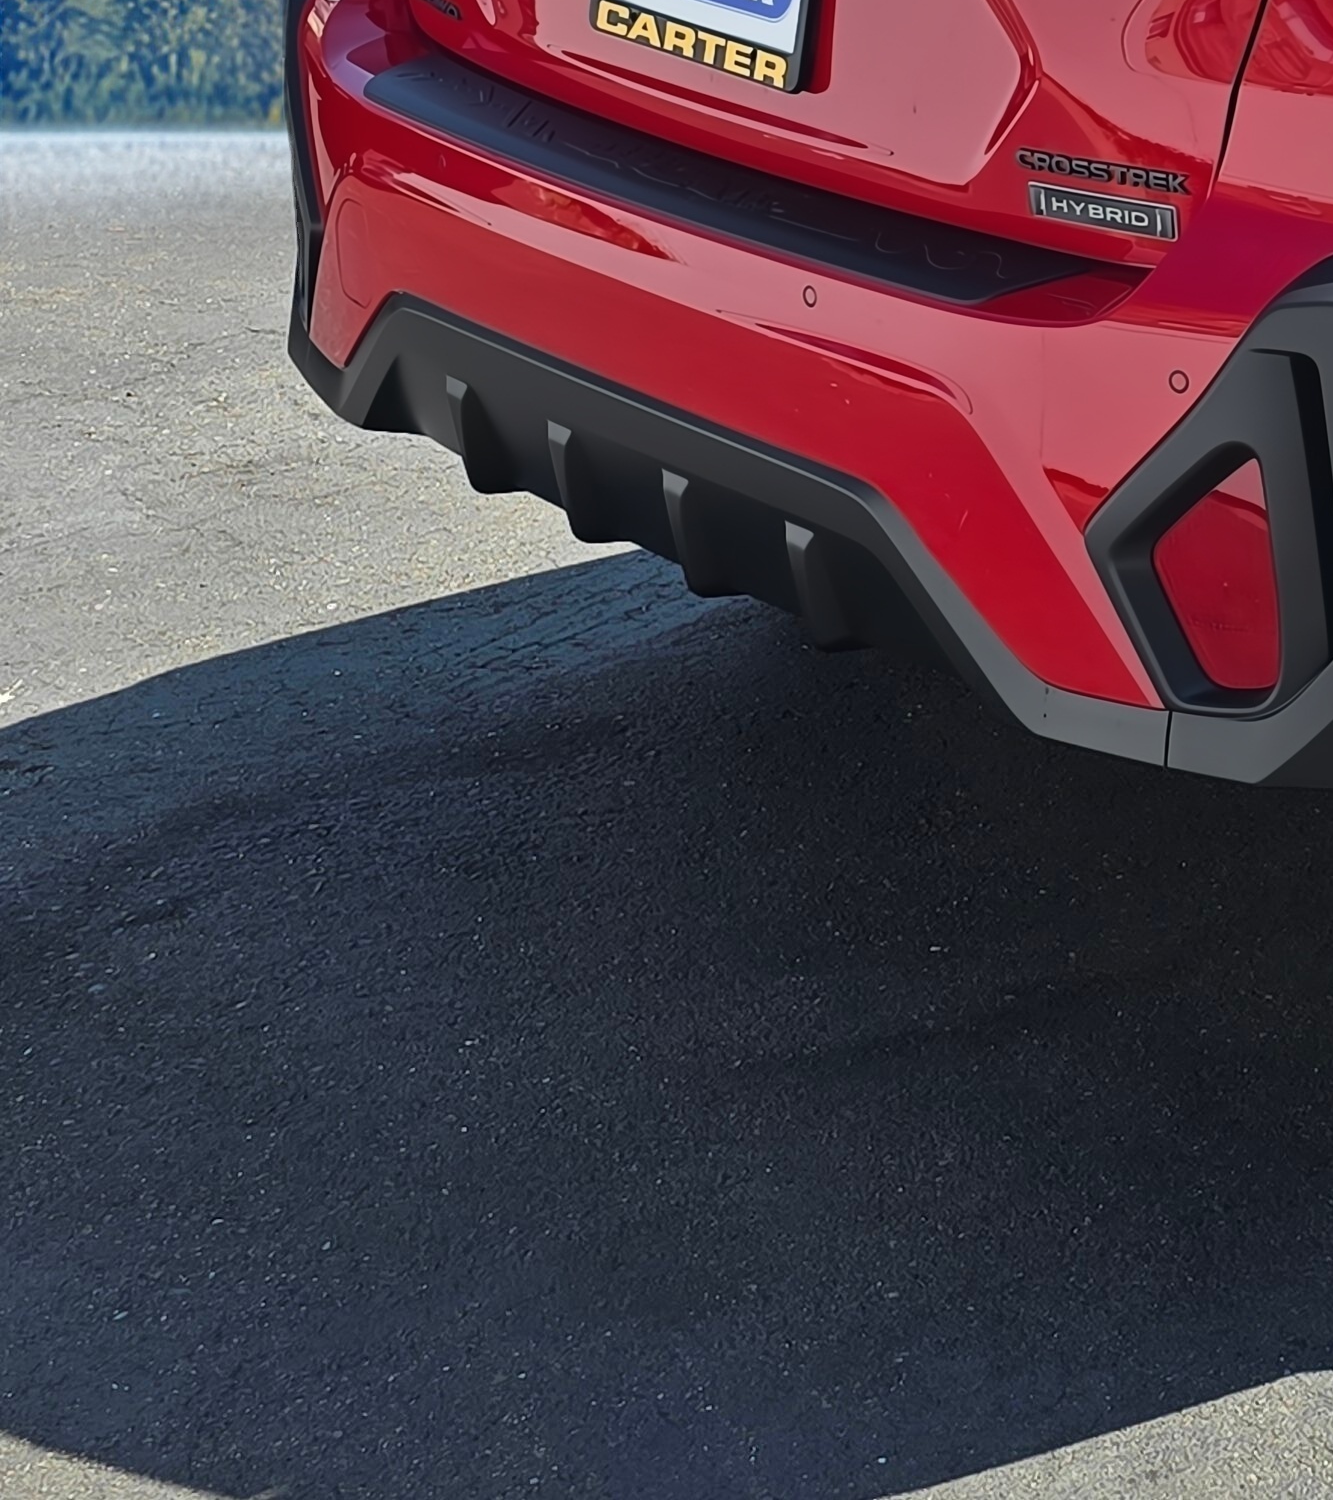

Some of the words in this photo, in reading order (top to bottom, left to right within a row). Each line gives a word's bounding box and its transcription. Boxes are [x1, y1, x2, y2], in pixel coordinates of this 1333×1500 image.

[596, 0, 787, 89] CARTER
[1015, 147, 1191, 195] CROSSTREK
[1051, 196, 1149, 228] HYBRID
